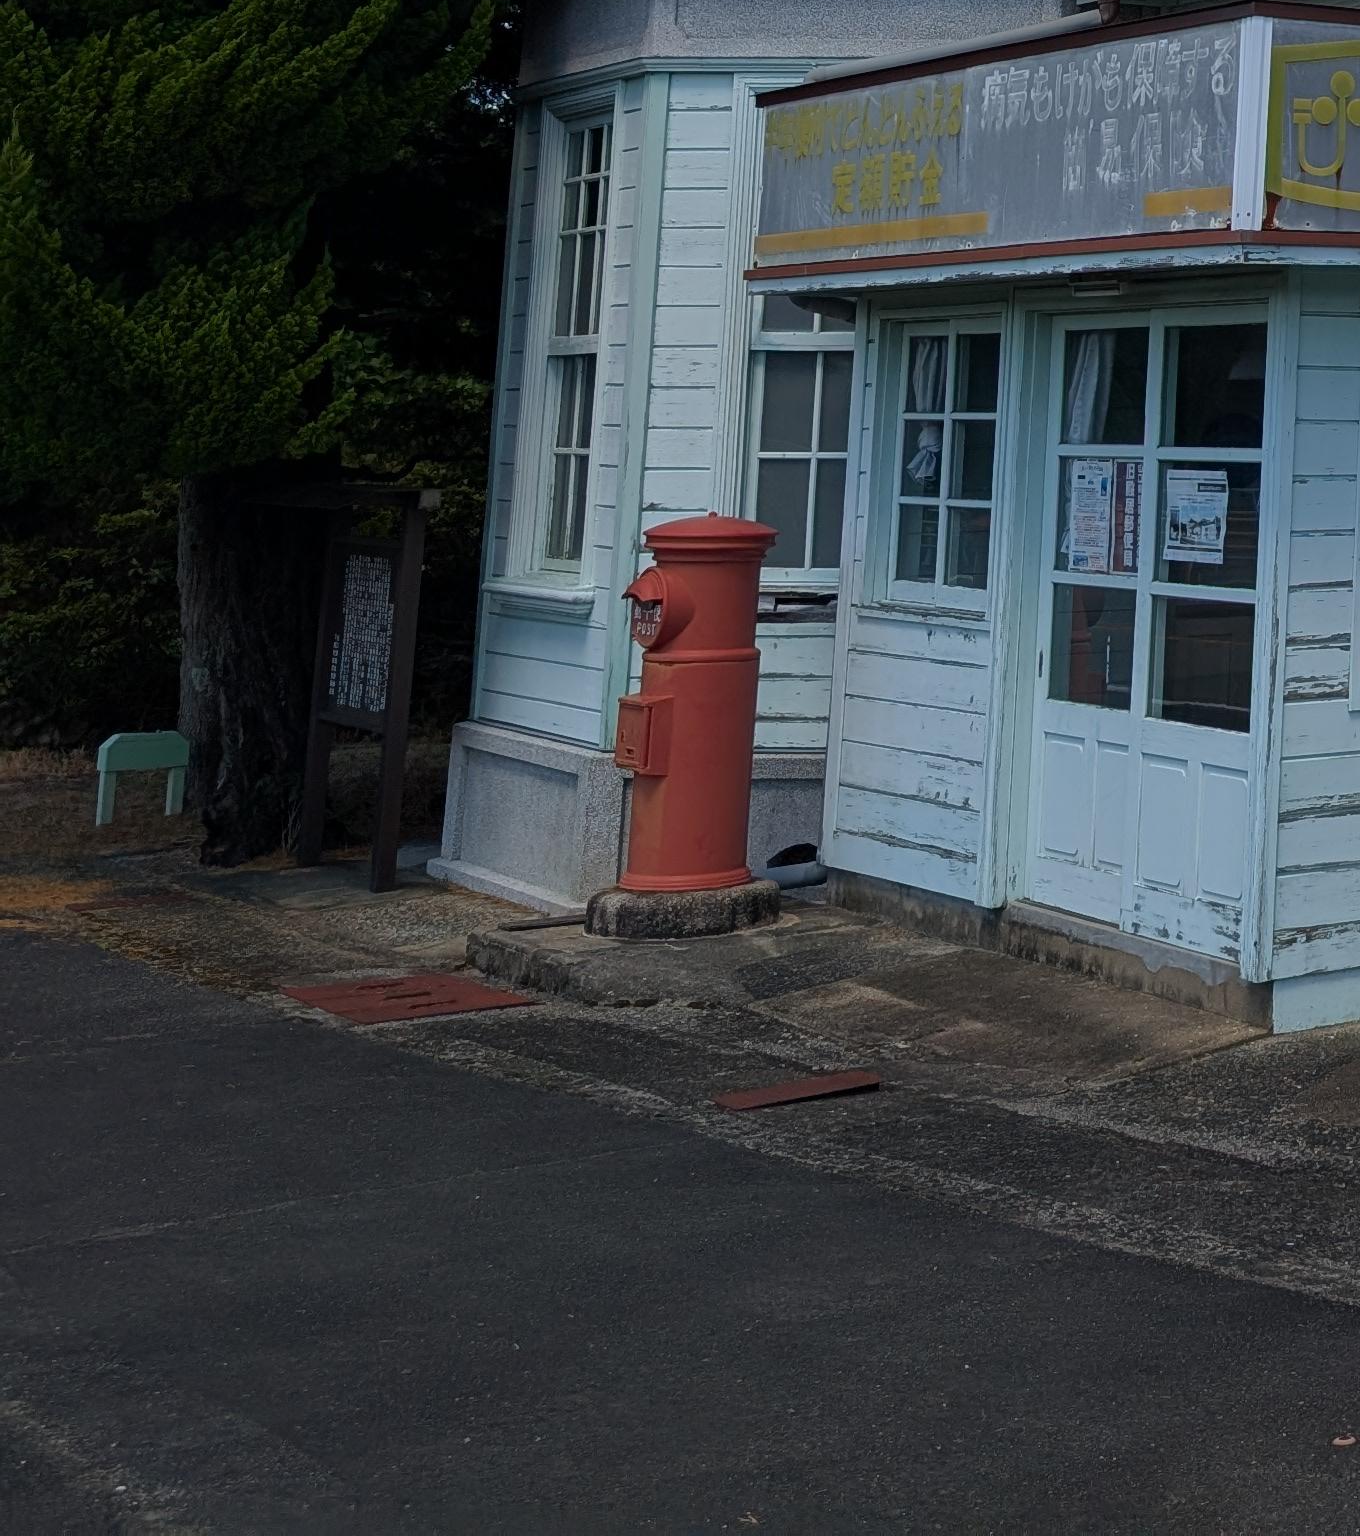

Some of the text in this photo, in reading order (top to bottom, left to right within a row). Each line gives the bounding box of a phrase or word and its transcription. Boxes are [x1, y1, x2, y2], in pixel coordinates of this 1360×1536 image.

[981, 34, 1236, 130] 病気もけがも保障する
[832, 149, 944, 214] 定額貯金
[636, 621, 656, 636] POST
